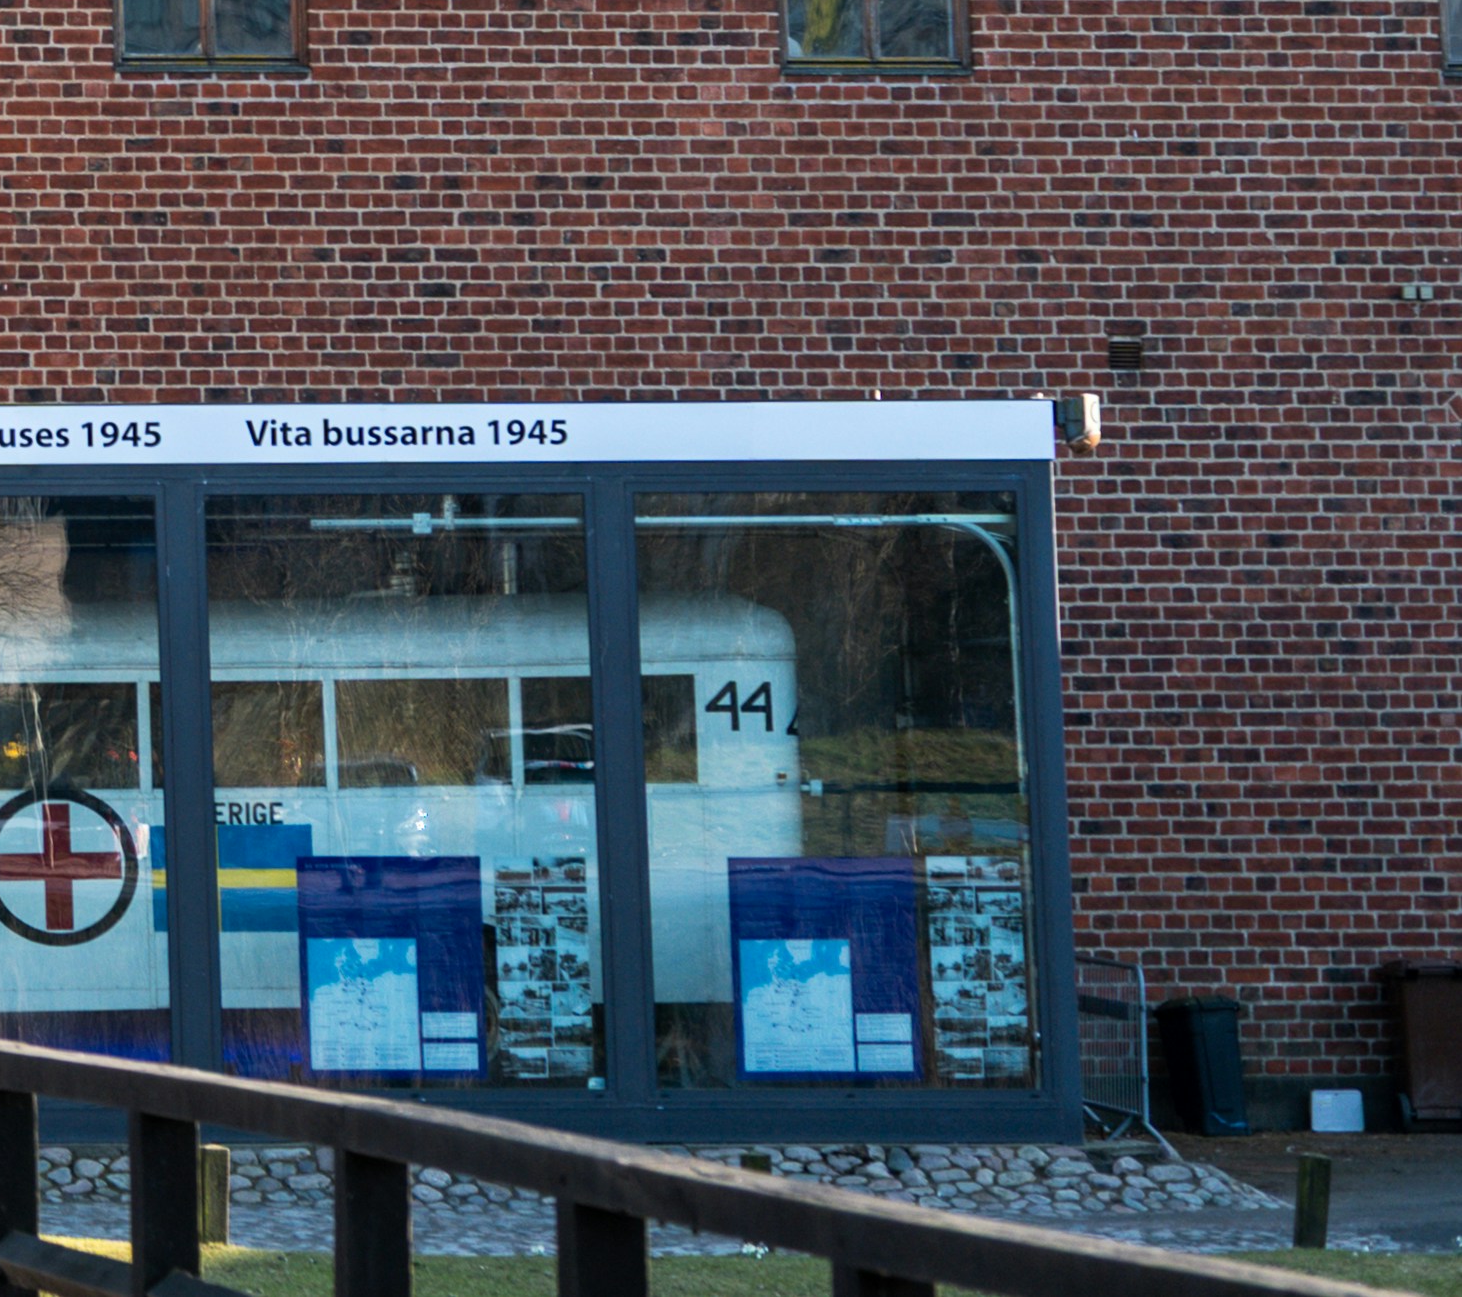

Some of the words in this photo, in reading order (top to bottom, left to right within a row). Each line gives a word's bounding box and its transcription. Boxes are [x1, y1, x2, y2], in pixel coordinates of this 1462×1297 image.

[81, 421, 162, 448] 1945
[245, 419, 312, 447] Vita
[322, 418, 476, 447] bussarna
[487, 419, 568, 446] 1945
[704, 680, 774, 733] 44
